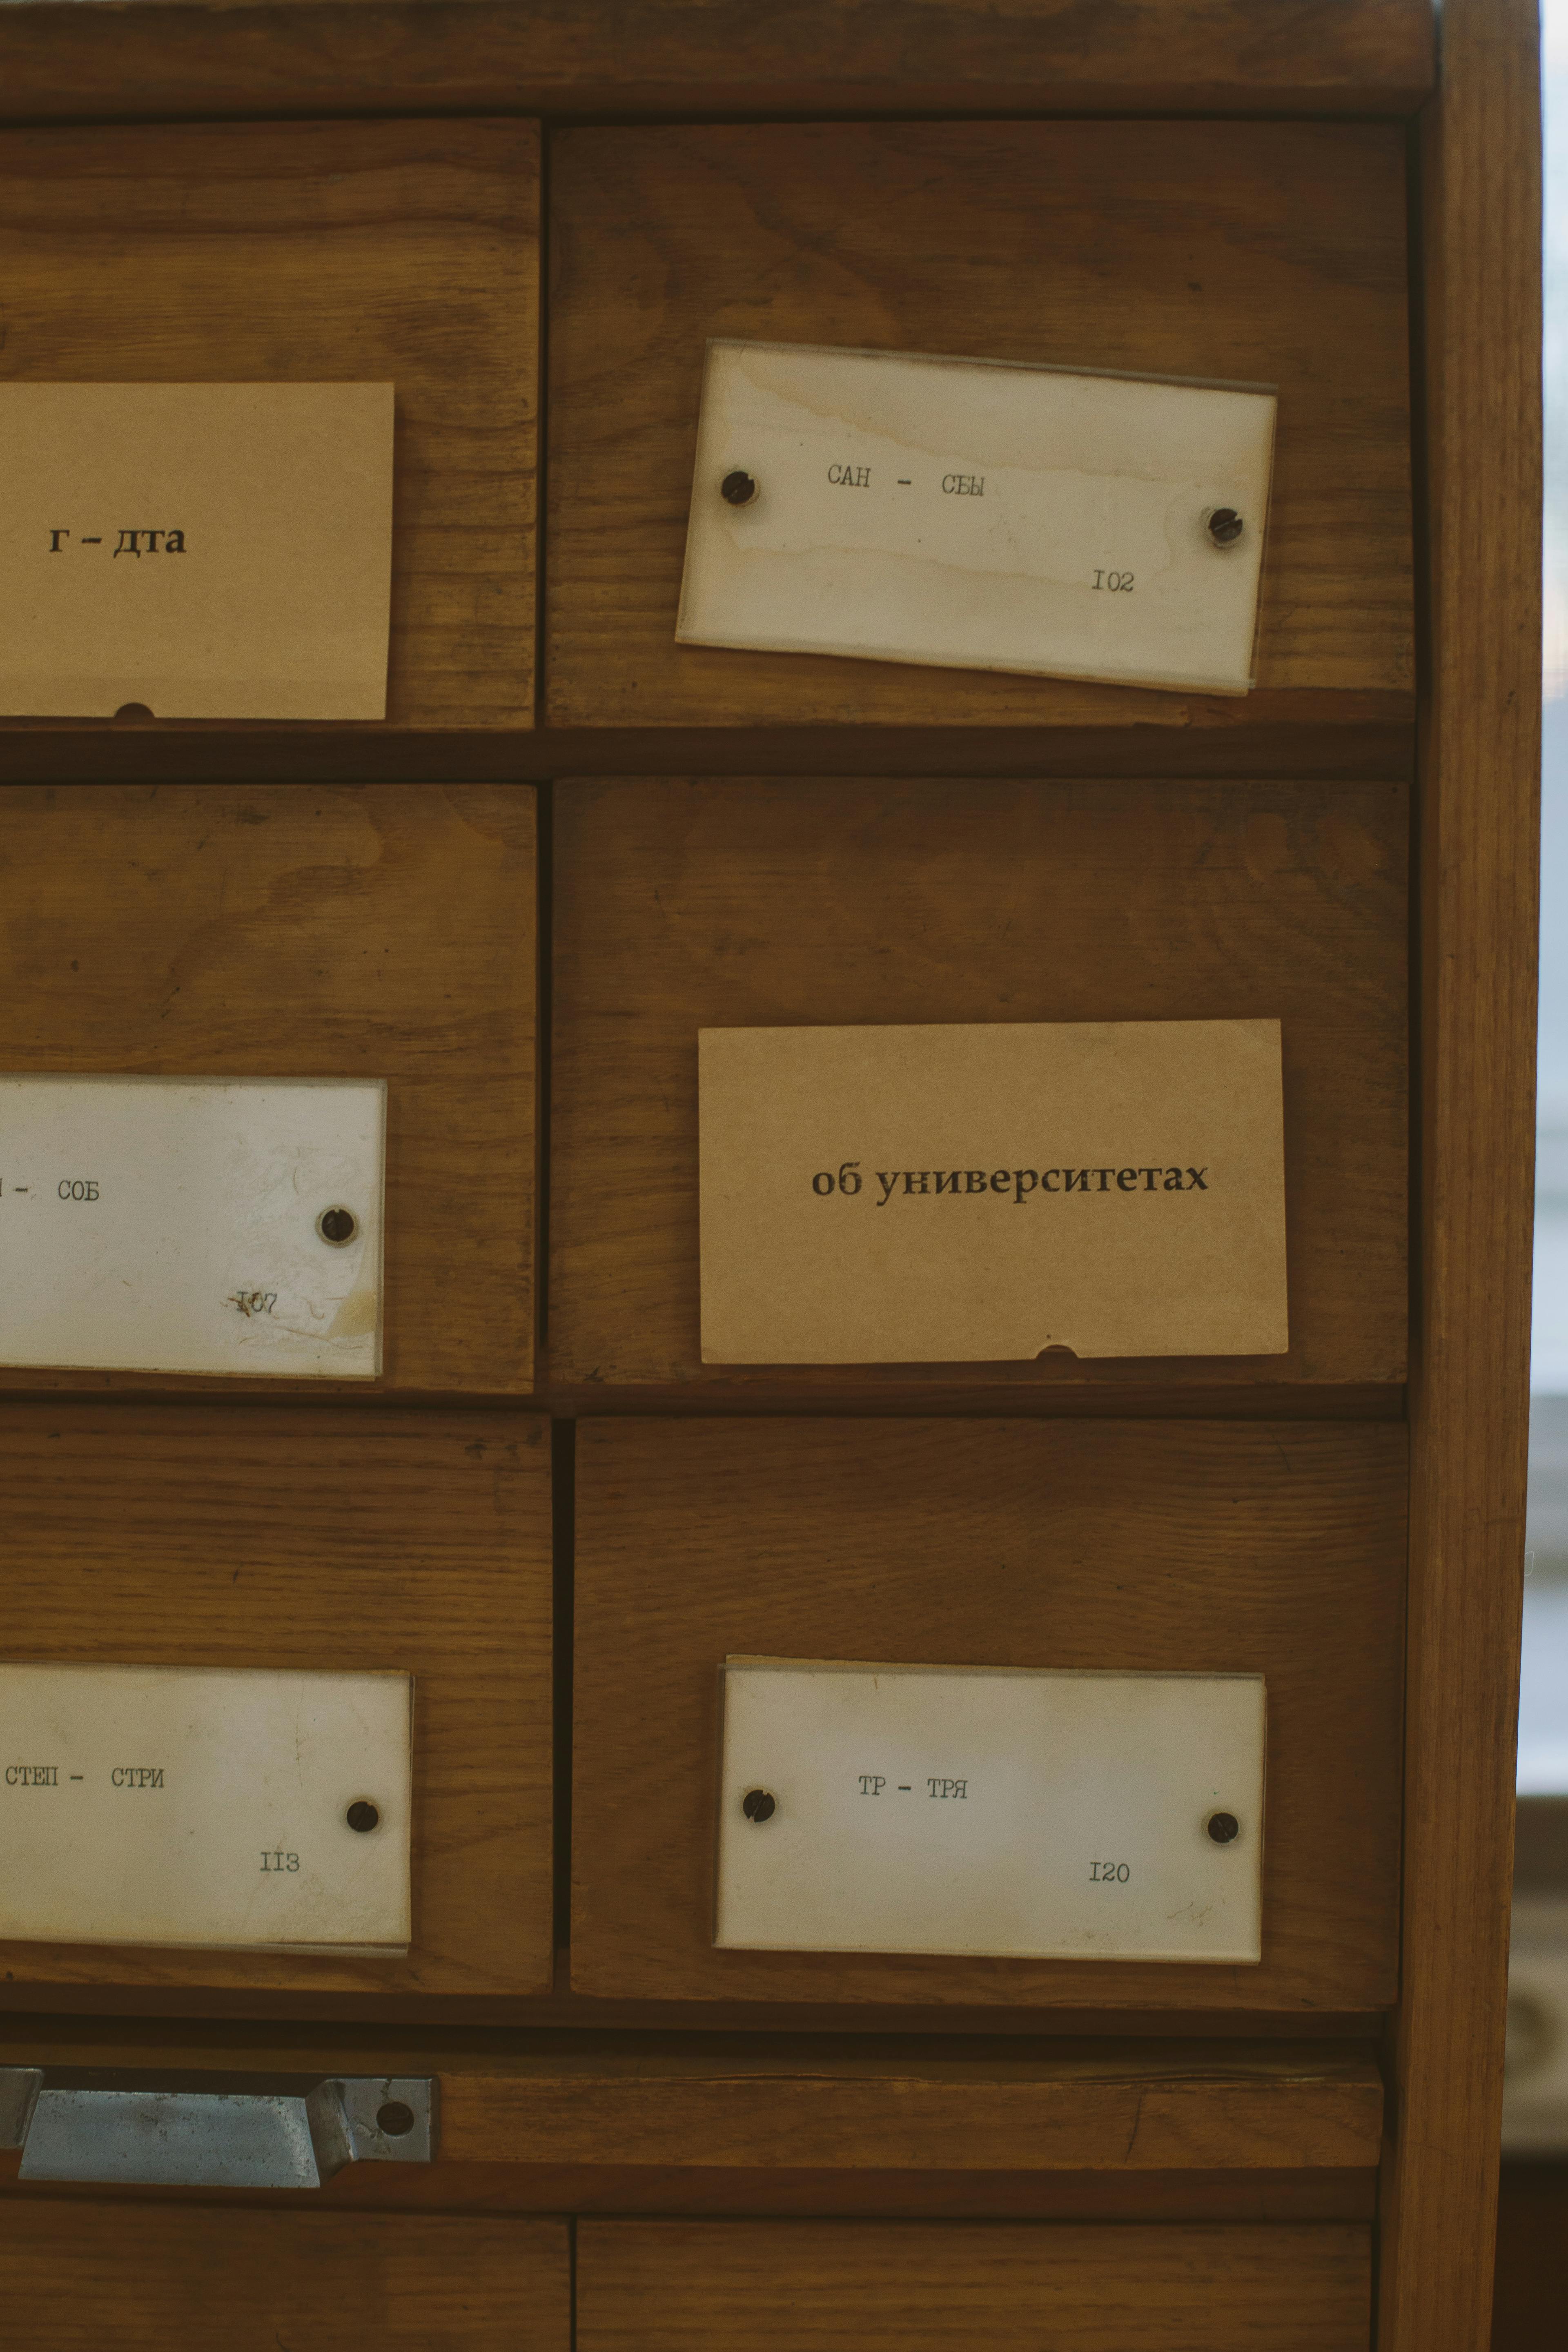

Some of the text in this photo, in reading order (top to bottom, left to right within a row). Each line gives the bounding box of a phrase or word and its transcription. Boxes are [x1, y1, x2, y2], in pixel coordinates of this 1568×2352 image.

[827, 464, 871, 488] САН
[941, 474, 985, 497] СБЫ
[49, 529, 70, 552] г
[113, 530, 187, 558] дта
[58, 1179, 100, 1201] СОБ
[812, 1162, 1209, 1207] об университетах
[5, 1766, 58, 1786] СТЕП
[111, 1767, 164, 1788] СТРИ
[858, 1775, 886, 1796] ТР
[927, 1778, 968, 1799] ТРЯ
